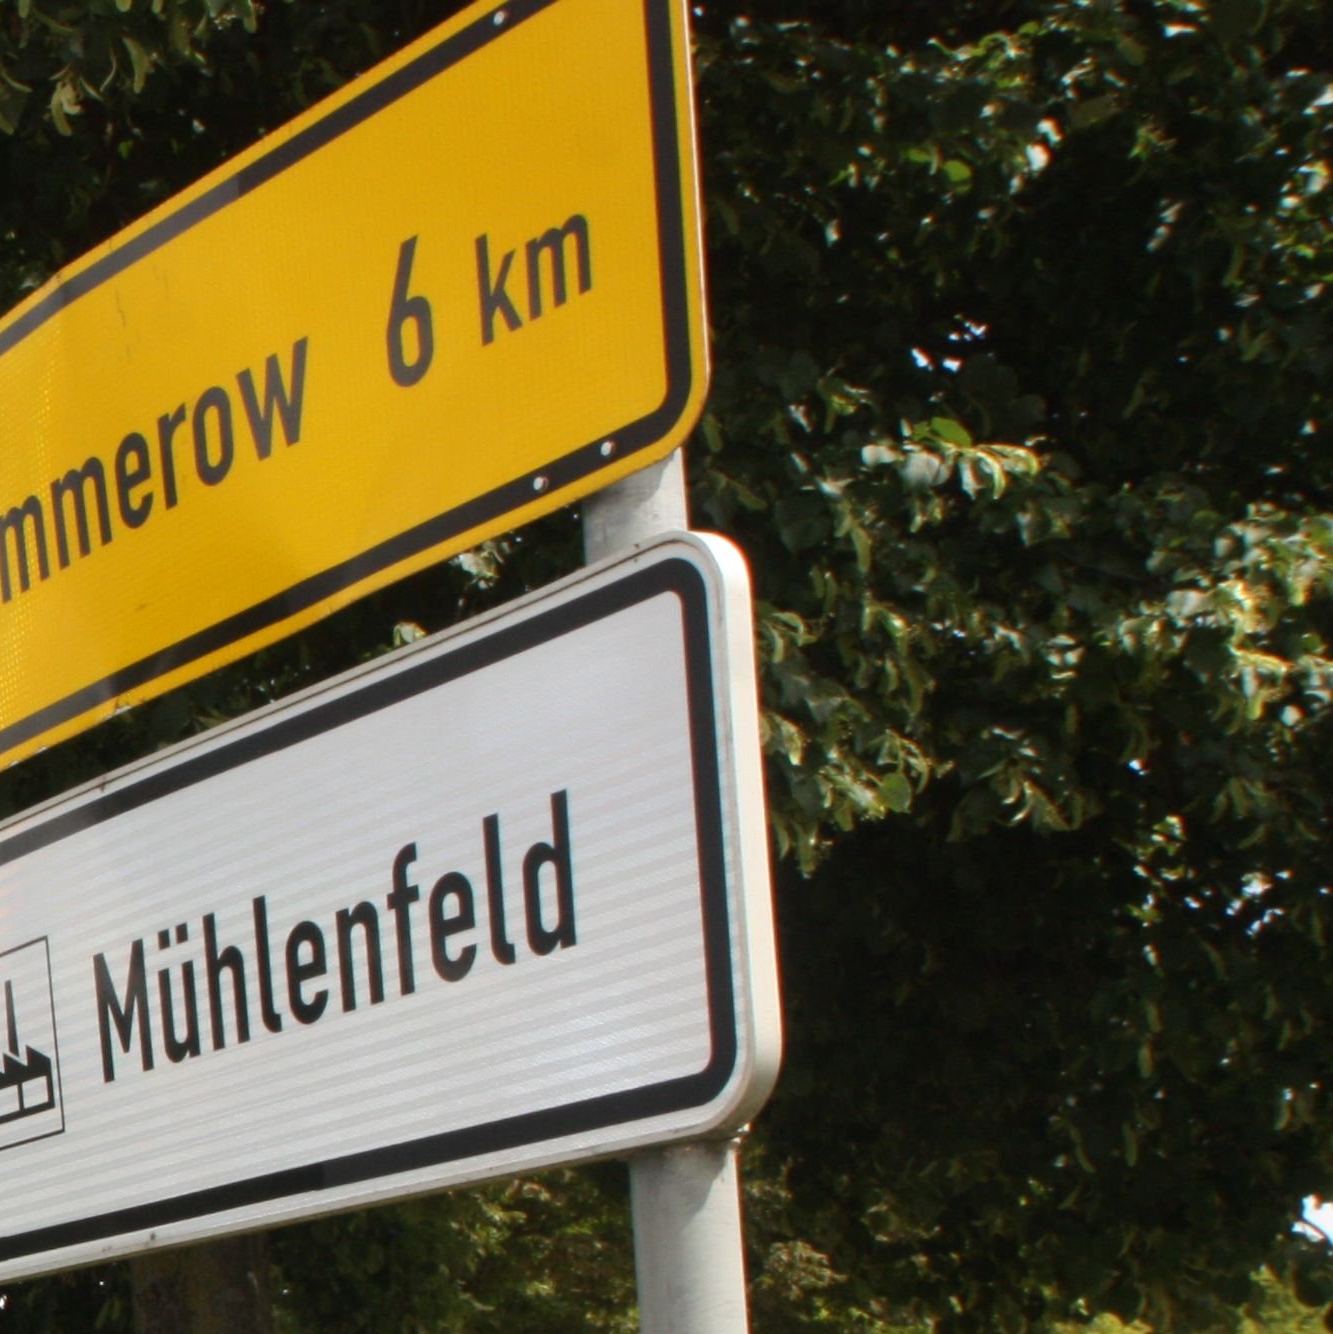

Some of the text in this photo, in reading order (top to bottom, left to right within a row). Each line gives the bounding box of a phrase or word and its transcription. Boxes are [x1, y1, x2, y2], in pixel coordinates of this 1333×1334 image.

[386, 235, 434, 388] 6
[474, 212, 593, 347] km
[93, 788, 578, 1084] Mühlenfeld
